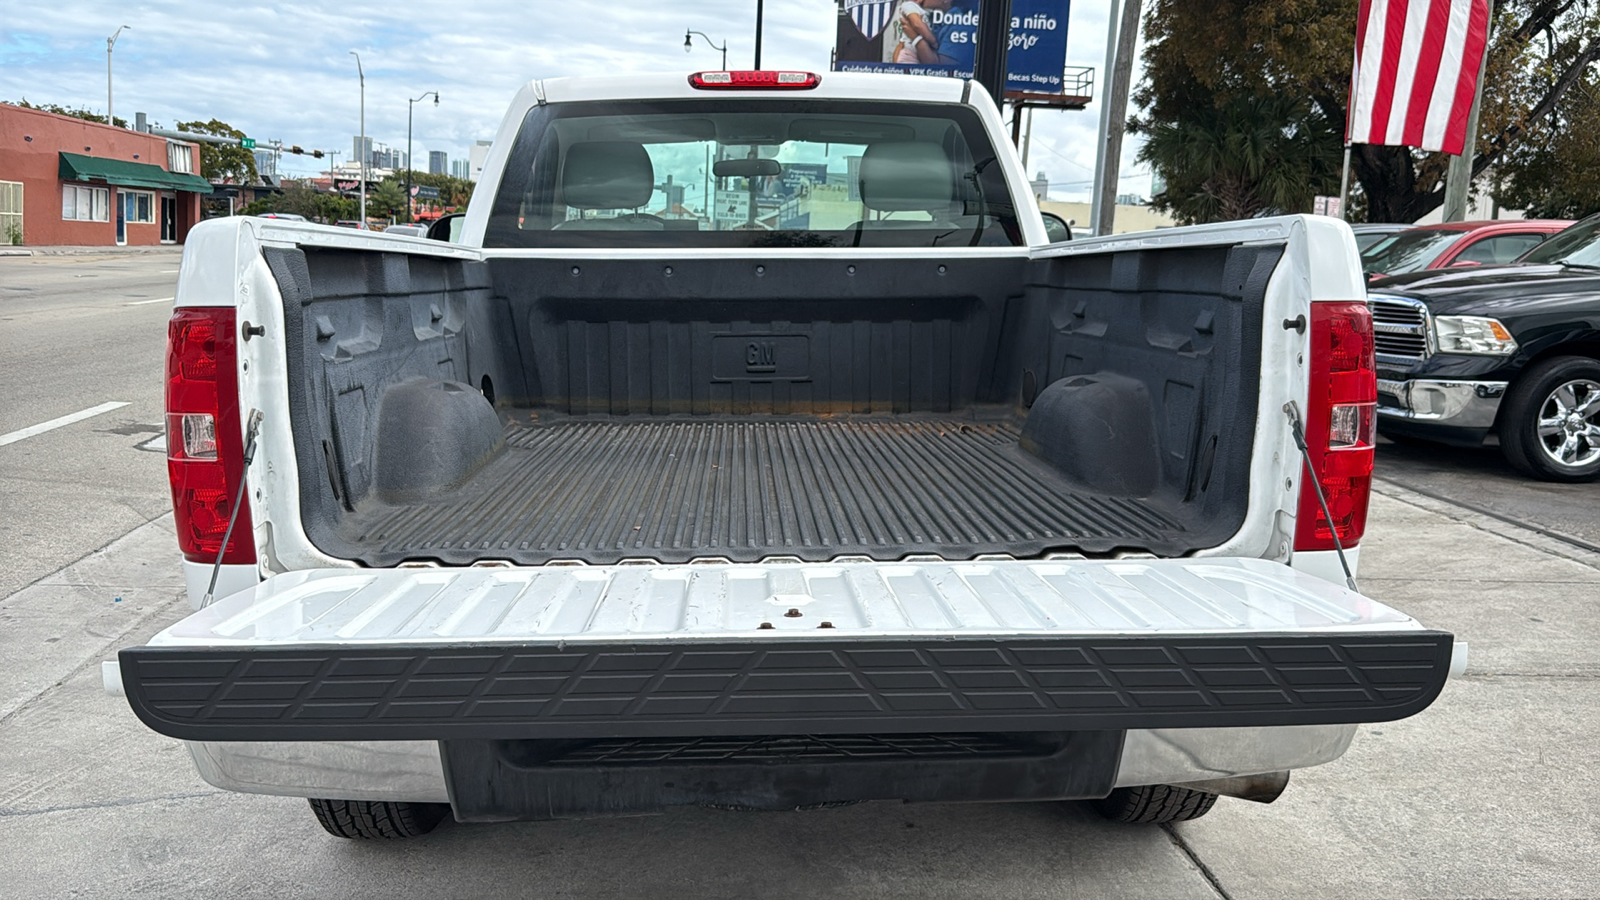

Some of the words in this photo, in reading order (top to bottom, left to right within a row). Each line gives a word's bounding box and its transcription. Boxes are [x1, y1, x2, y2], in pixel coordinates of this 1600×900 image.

[932, 10, 979, 26] Donde
[1023, 14, 1057, 31] niño
[950, 31, 968, 43] es
[909, 68, 925, 76] VPK
[926, 69, 948, 77] Gratis
[1008, 73, 1030, 82] Becas
[1031, 74, 1048, 84] Step
[1049, 76, 1060, 85] Up
[746, 341, 776, 366] GM
